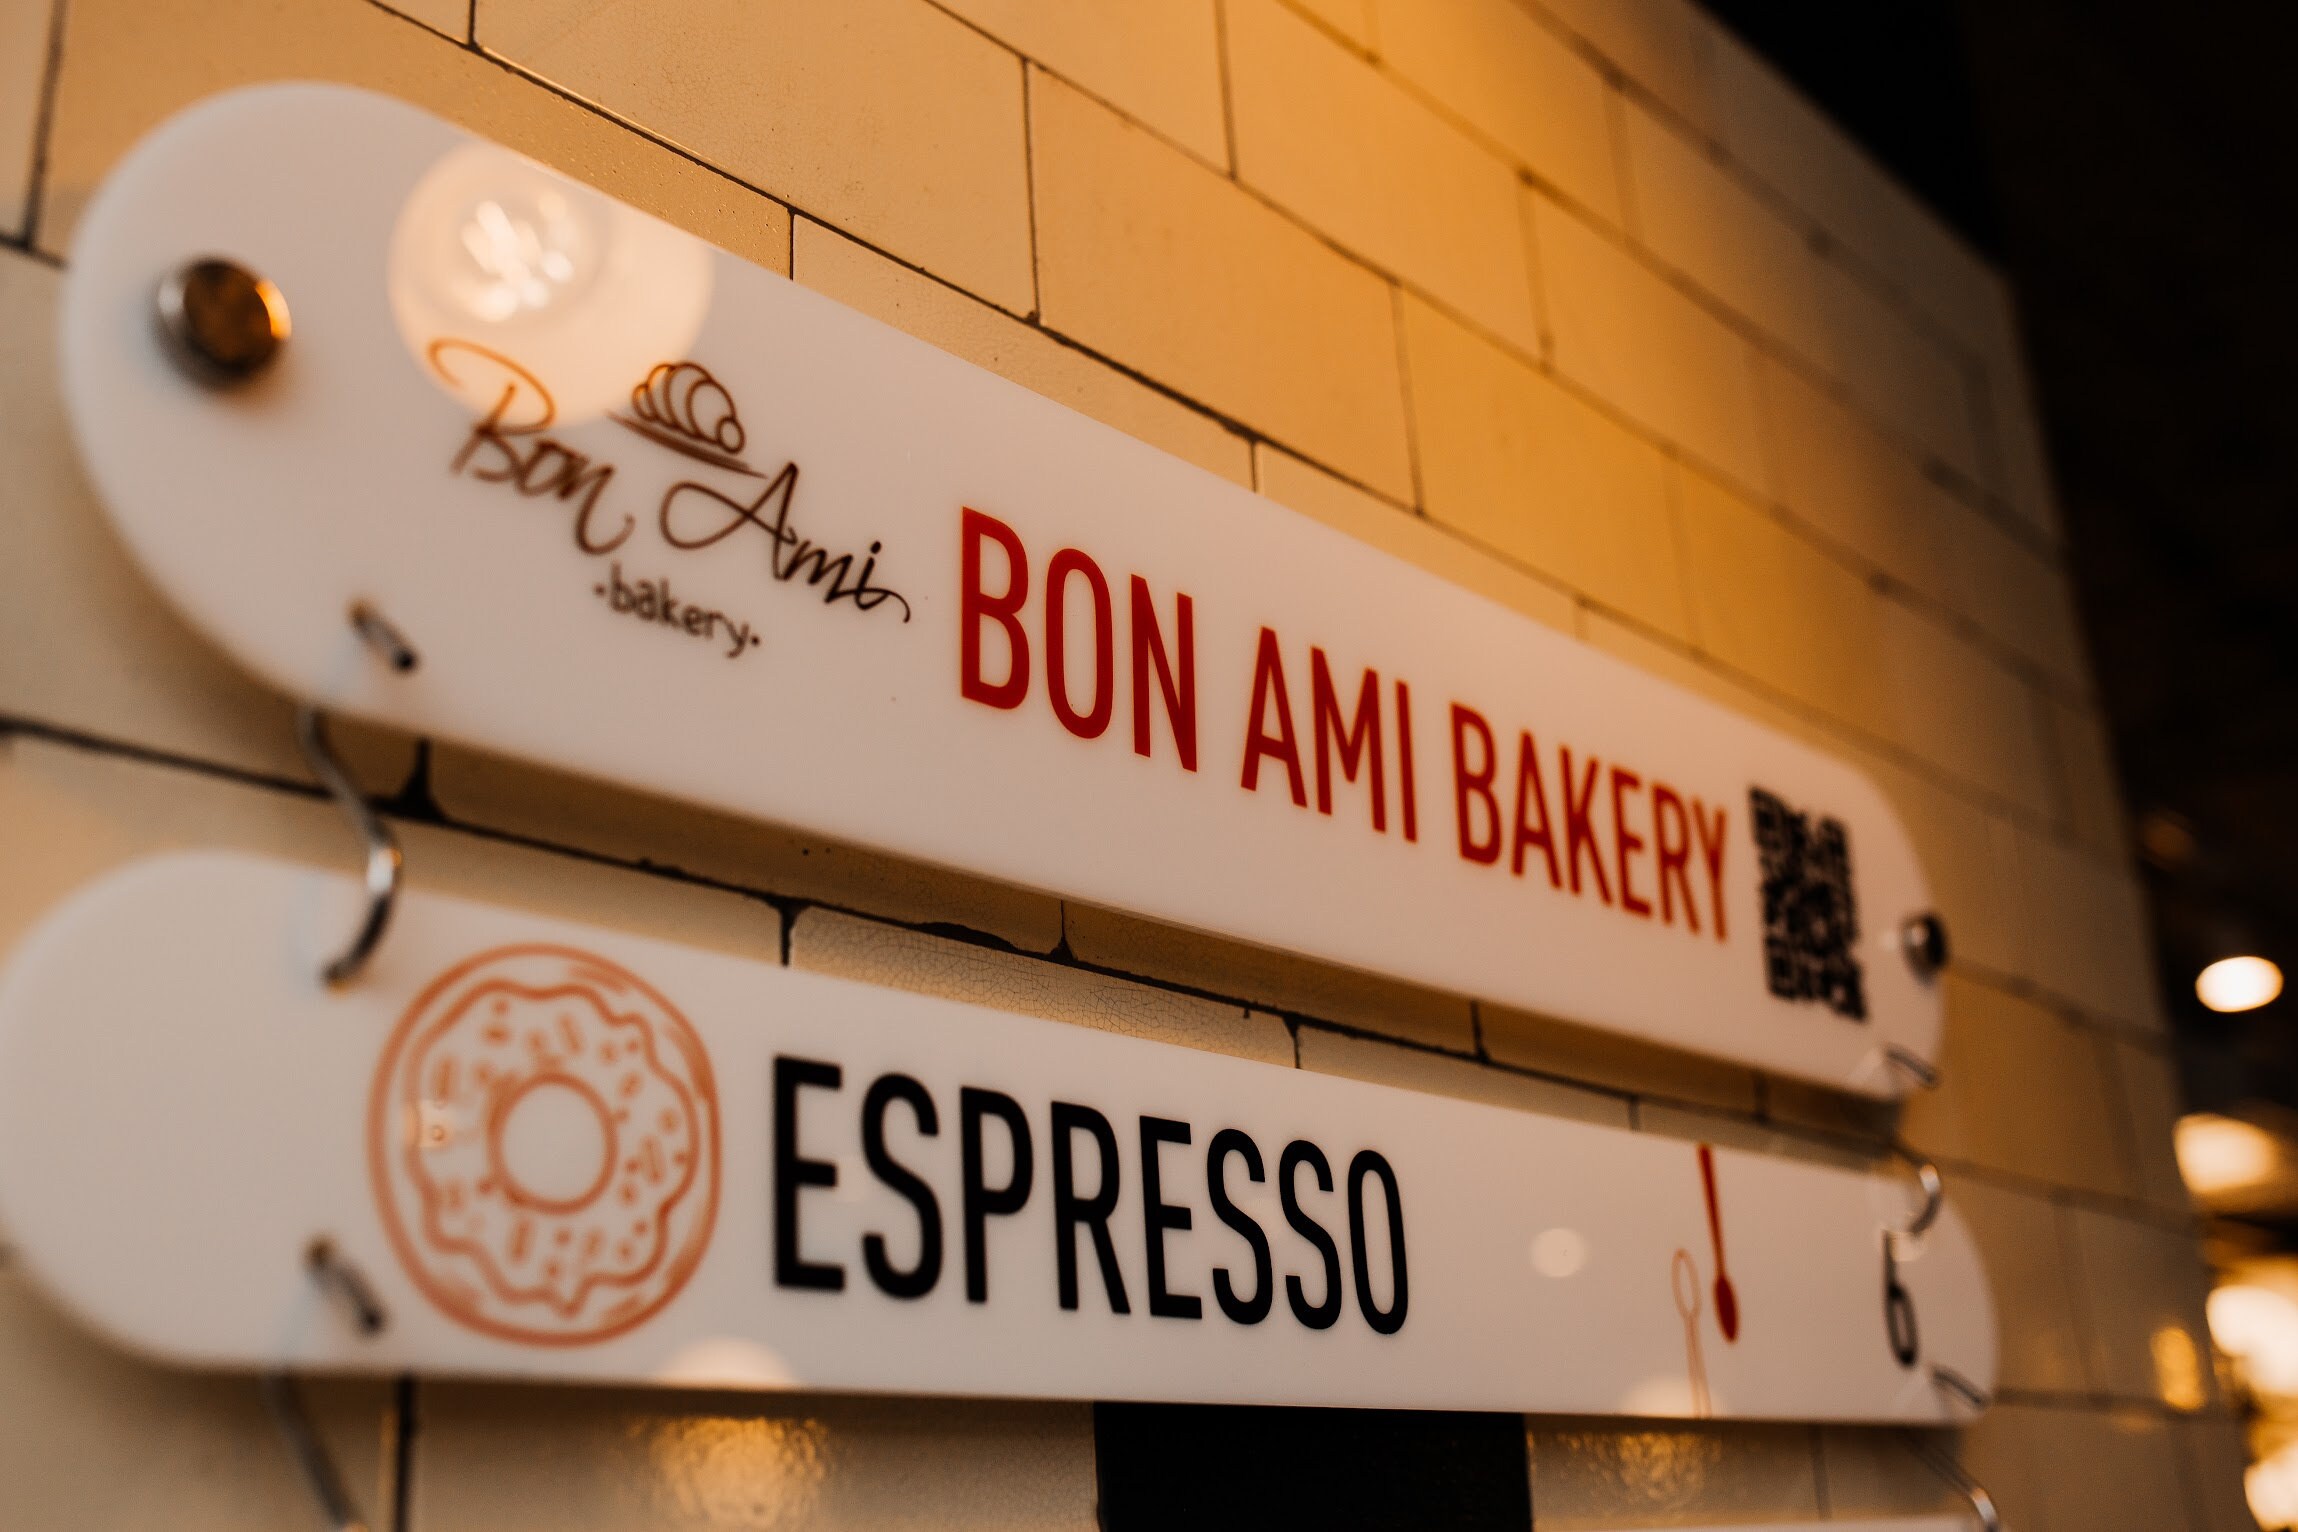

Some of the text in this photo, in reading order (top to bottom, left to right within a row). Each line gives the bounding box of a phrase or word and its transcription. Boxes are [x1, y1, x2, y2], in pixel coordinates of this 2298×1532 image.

[429, 338, 911, 624] Bon Ami
[960, 506, 1729, 941] BON AMI BAKERY
[773, 1055, 1409, 1335] ESPRESSO
